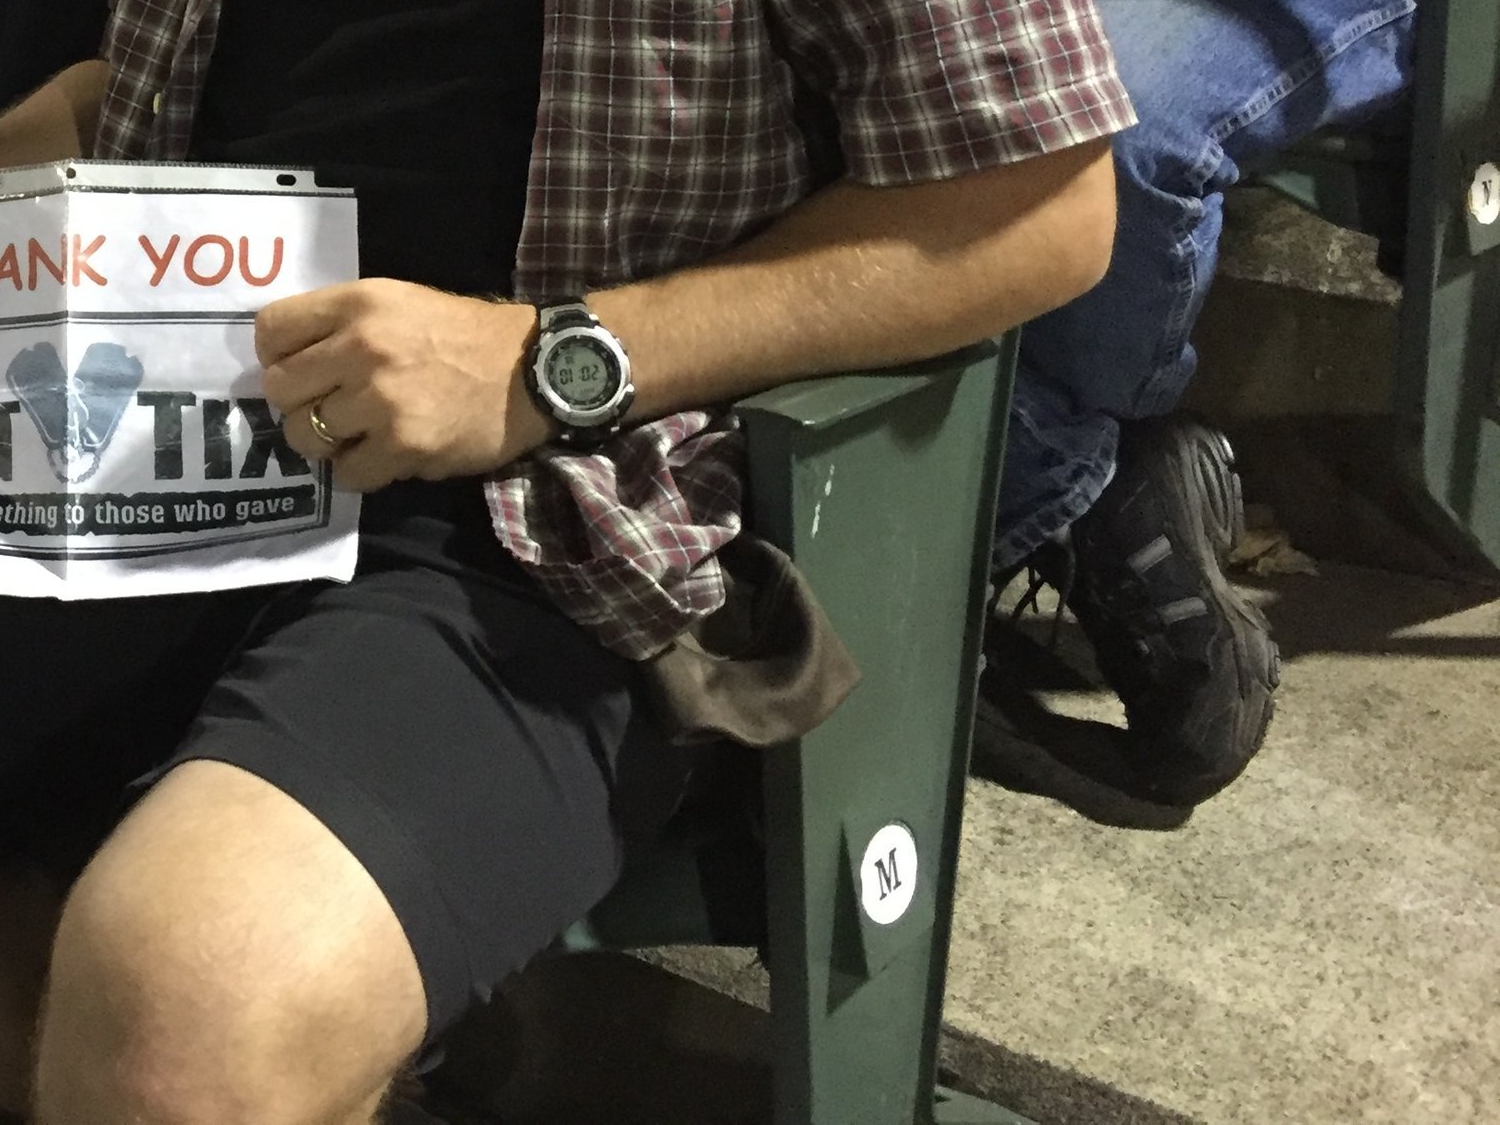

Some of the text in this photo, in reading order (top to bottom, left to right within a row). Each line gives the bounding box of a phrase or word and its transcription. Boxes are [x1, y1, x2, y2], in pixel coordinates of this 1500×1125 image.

[137, 234, 284, 288] YOU
[137, 391, 311, 480] TIX
[64, 501, 85, 524] to
[95, 500, 165, 524] those
[174, 493, 226, 523] who
[235, 496, 295, 520] gave
[874, 847, 902, 901] M
